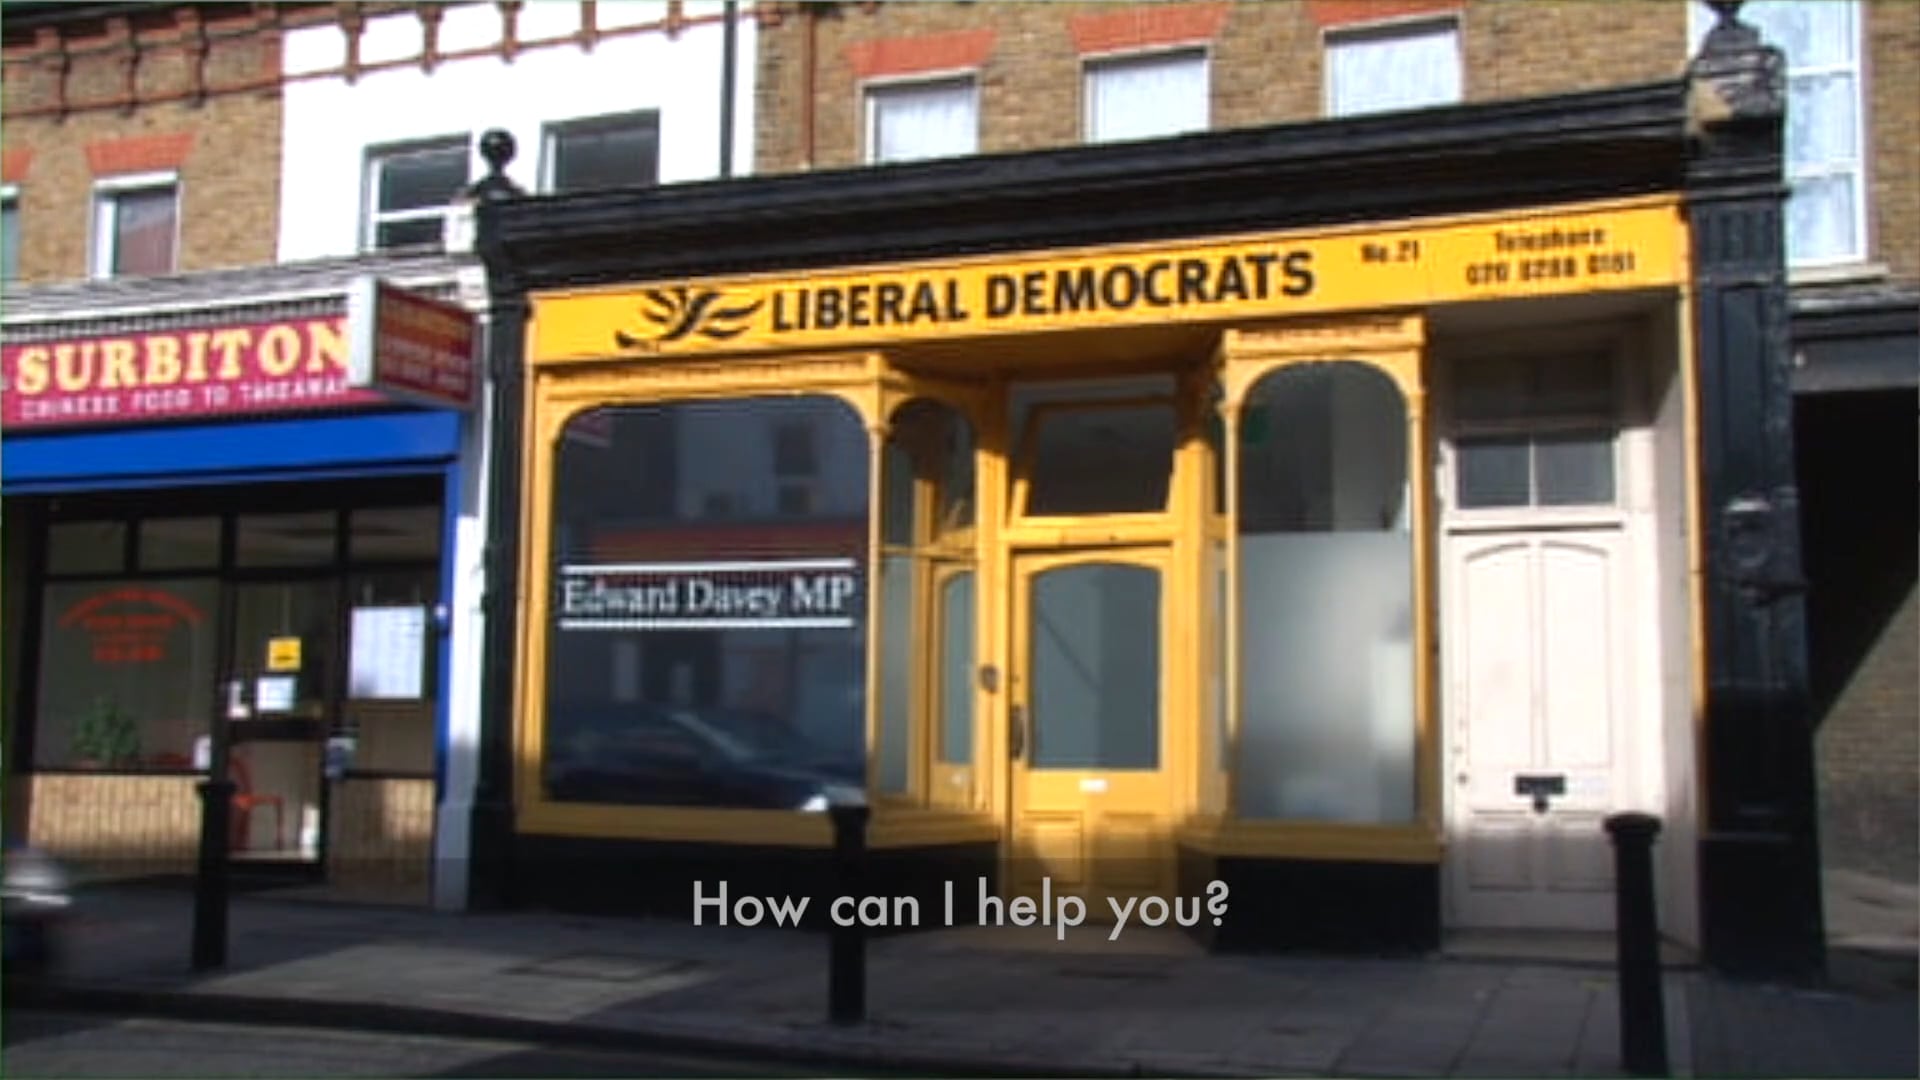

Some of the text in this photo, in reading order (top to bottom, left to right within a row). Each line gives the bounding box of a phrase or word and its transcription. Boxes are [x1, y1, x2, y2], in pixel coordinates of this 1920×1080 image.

[773, 252, 1315, 333] LIBERAL DEMOCRATS
[17, 319, 348, 395] SURBITON
[132, 388, 192, 411] FOOD
[205, 385, 231, 407] TO
[563, 574, 853, 616] Edward Davey MP
